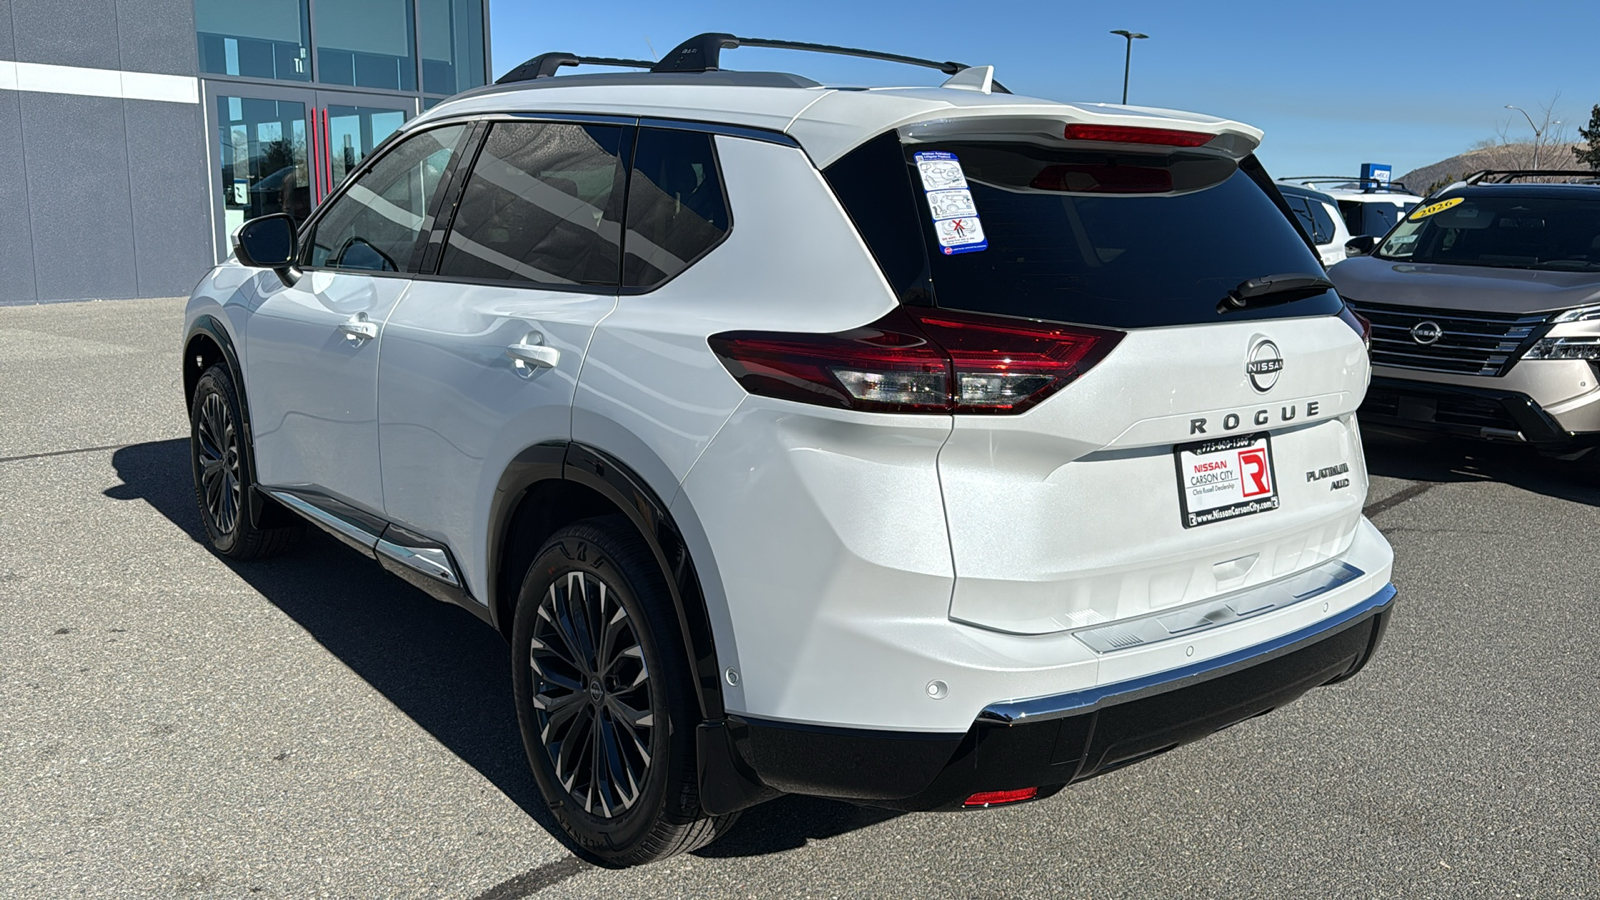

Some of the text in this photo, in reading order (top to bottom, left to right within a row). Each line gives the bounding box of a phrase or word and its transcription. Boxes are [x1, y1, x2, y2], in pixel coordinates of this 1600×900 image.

[1420, 201, 1453, 217] 2026
[1190, 401, 1319, 435] ROGUE
[1194, 460, 1227, 474] NISSAN
[1306, 462, 1349, 483] PLATINUM
[1190, 469, 1234, 486] CARSON CITY
[1329, 478, 1350, 492] AWD
[1192, 488, 1203, 496] Chris
[1215, 483, 1236, 492] Dealership
[1197, 502, 1272, 522] www.NissanCarsonCity.com
